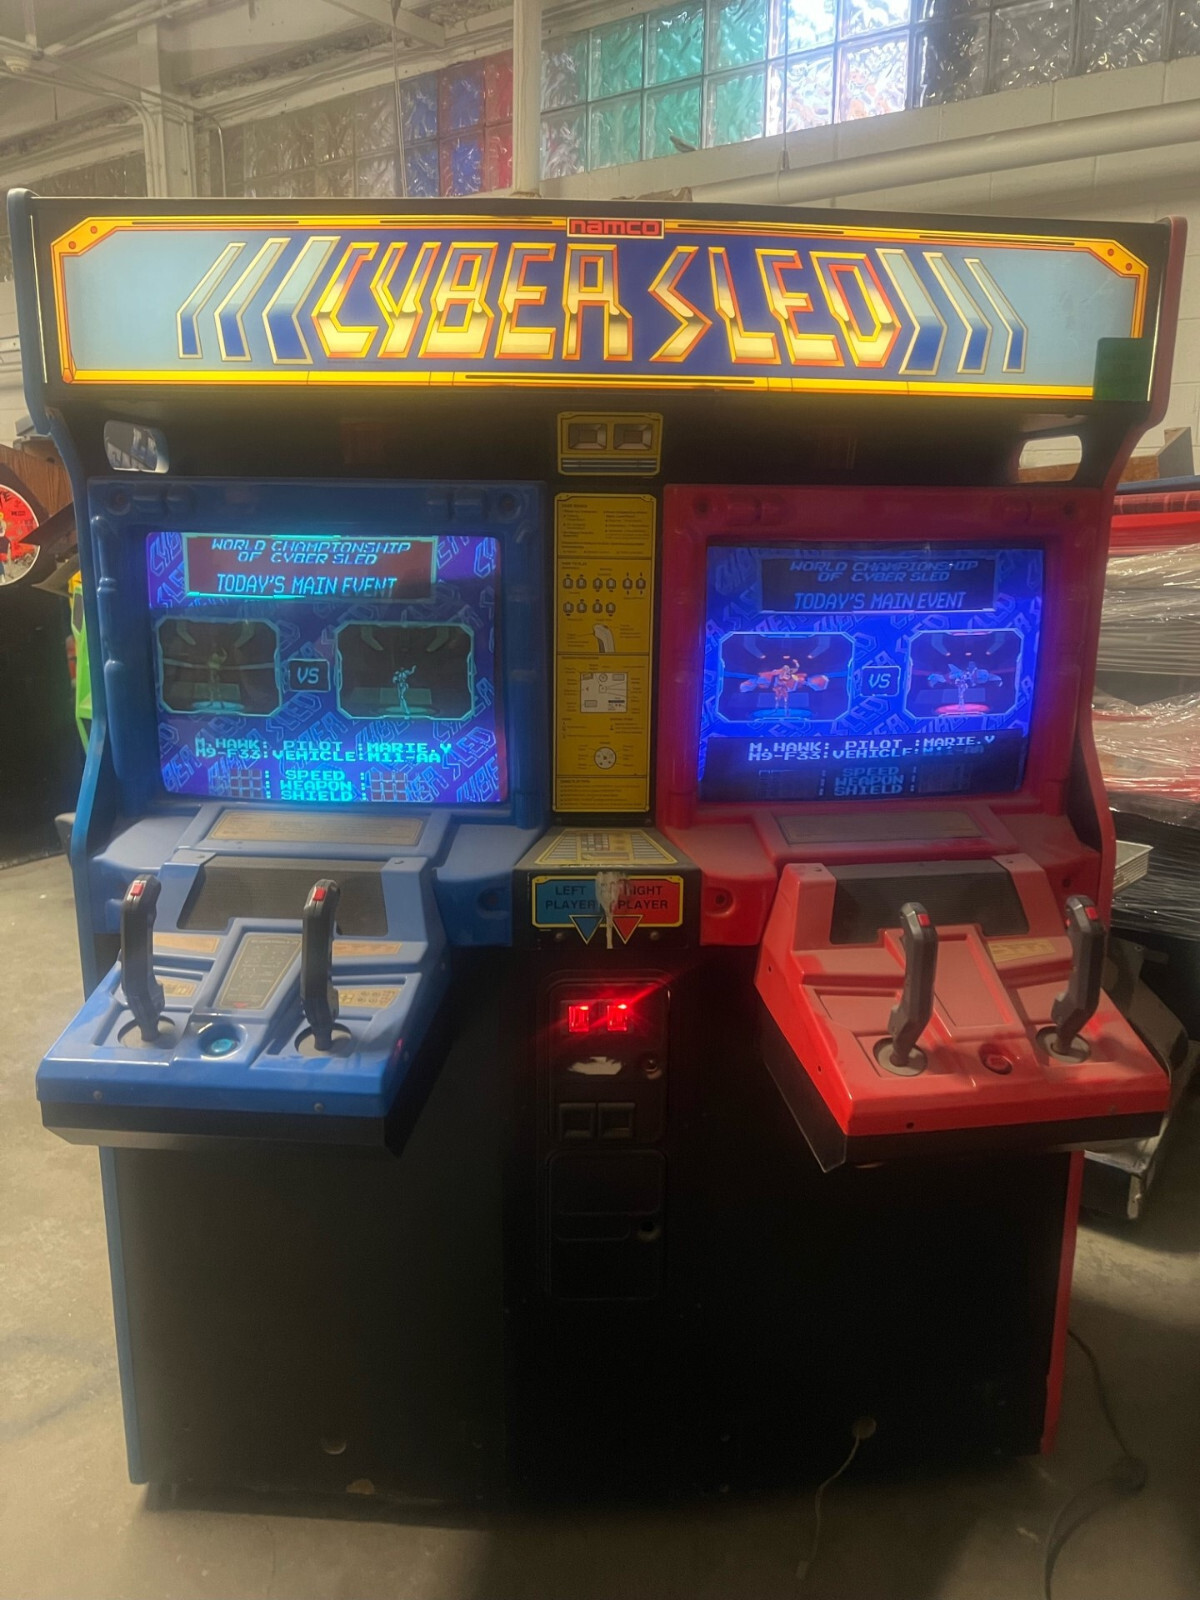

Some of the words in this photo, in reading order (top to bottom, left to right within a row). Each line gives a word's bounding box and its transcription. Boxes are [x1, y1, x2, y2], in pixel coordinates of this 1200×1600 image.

[570, 220, 660, 235] namco
[312, 242, 633, 361] CYBER
[649, 246, 902, 368] SLED
[211, 539, 266, 551] WORLD
[271, 541, 411, 555] CHAMPIONSHIP
[237, 551, 262, 563] OF
[271, 553, 329, 565] CYBER
[332, 554, 378, 565] SLED
[790, 560, 847, 572] WORLD
[852, 560, 978, 572] CHAMPIONSHIP
[818, 571, 844, 582] OF
[851, 571, 907, 582] CYBER
[910, 571, 950, 582] SLED
[217, 573, 286, 594] TODAY'S
[291, 576, 338, 595] MAIN
[342, 577, 397, 597] EVENT
[794, 592, 866, 610] TODAY'S
[869, 592, 915, 610] MAIN
[917, 591, 967, 610] EVENT
[297, 667, 320, 685] VS
[868, 673, 892, 689] VS
[283, 740, 343, 751] PILOT
[845, 739, 903, 751] PILOT
[285, 769, 346, 782] SPEED
[842, 766, 900, 777] SPEED
[280, 780, 353, 792] WEAPON
[835, 775, 905, 787] WEAPON
[281, 790, 354, 802] SHIELD
[834, 785, 904, 797] SHIELD
[555, 885, 586, 896] LEFT
[545, 900, 596, 910] PLAYER
[618, 900, 669, 910] PLAYER
